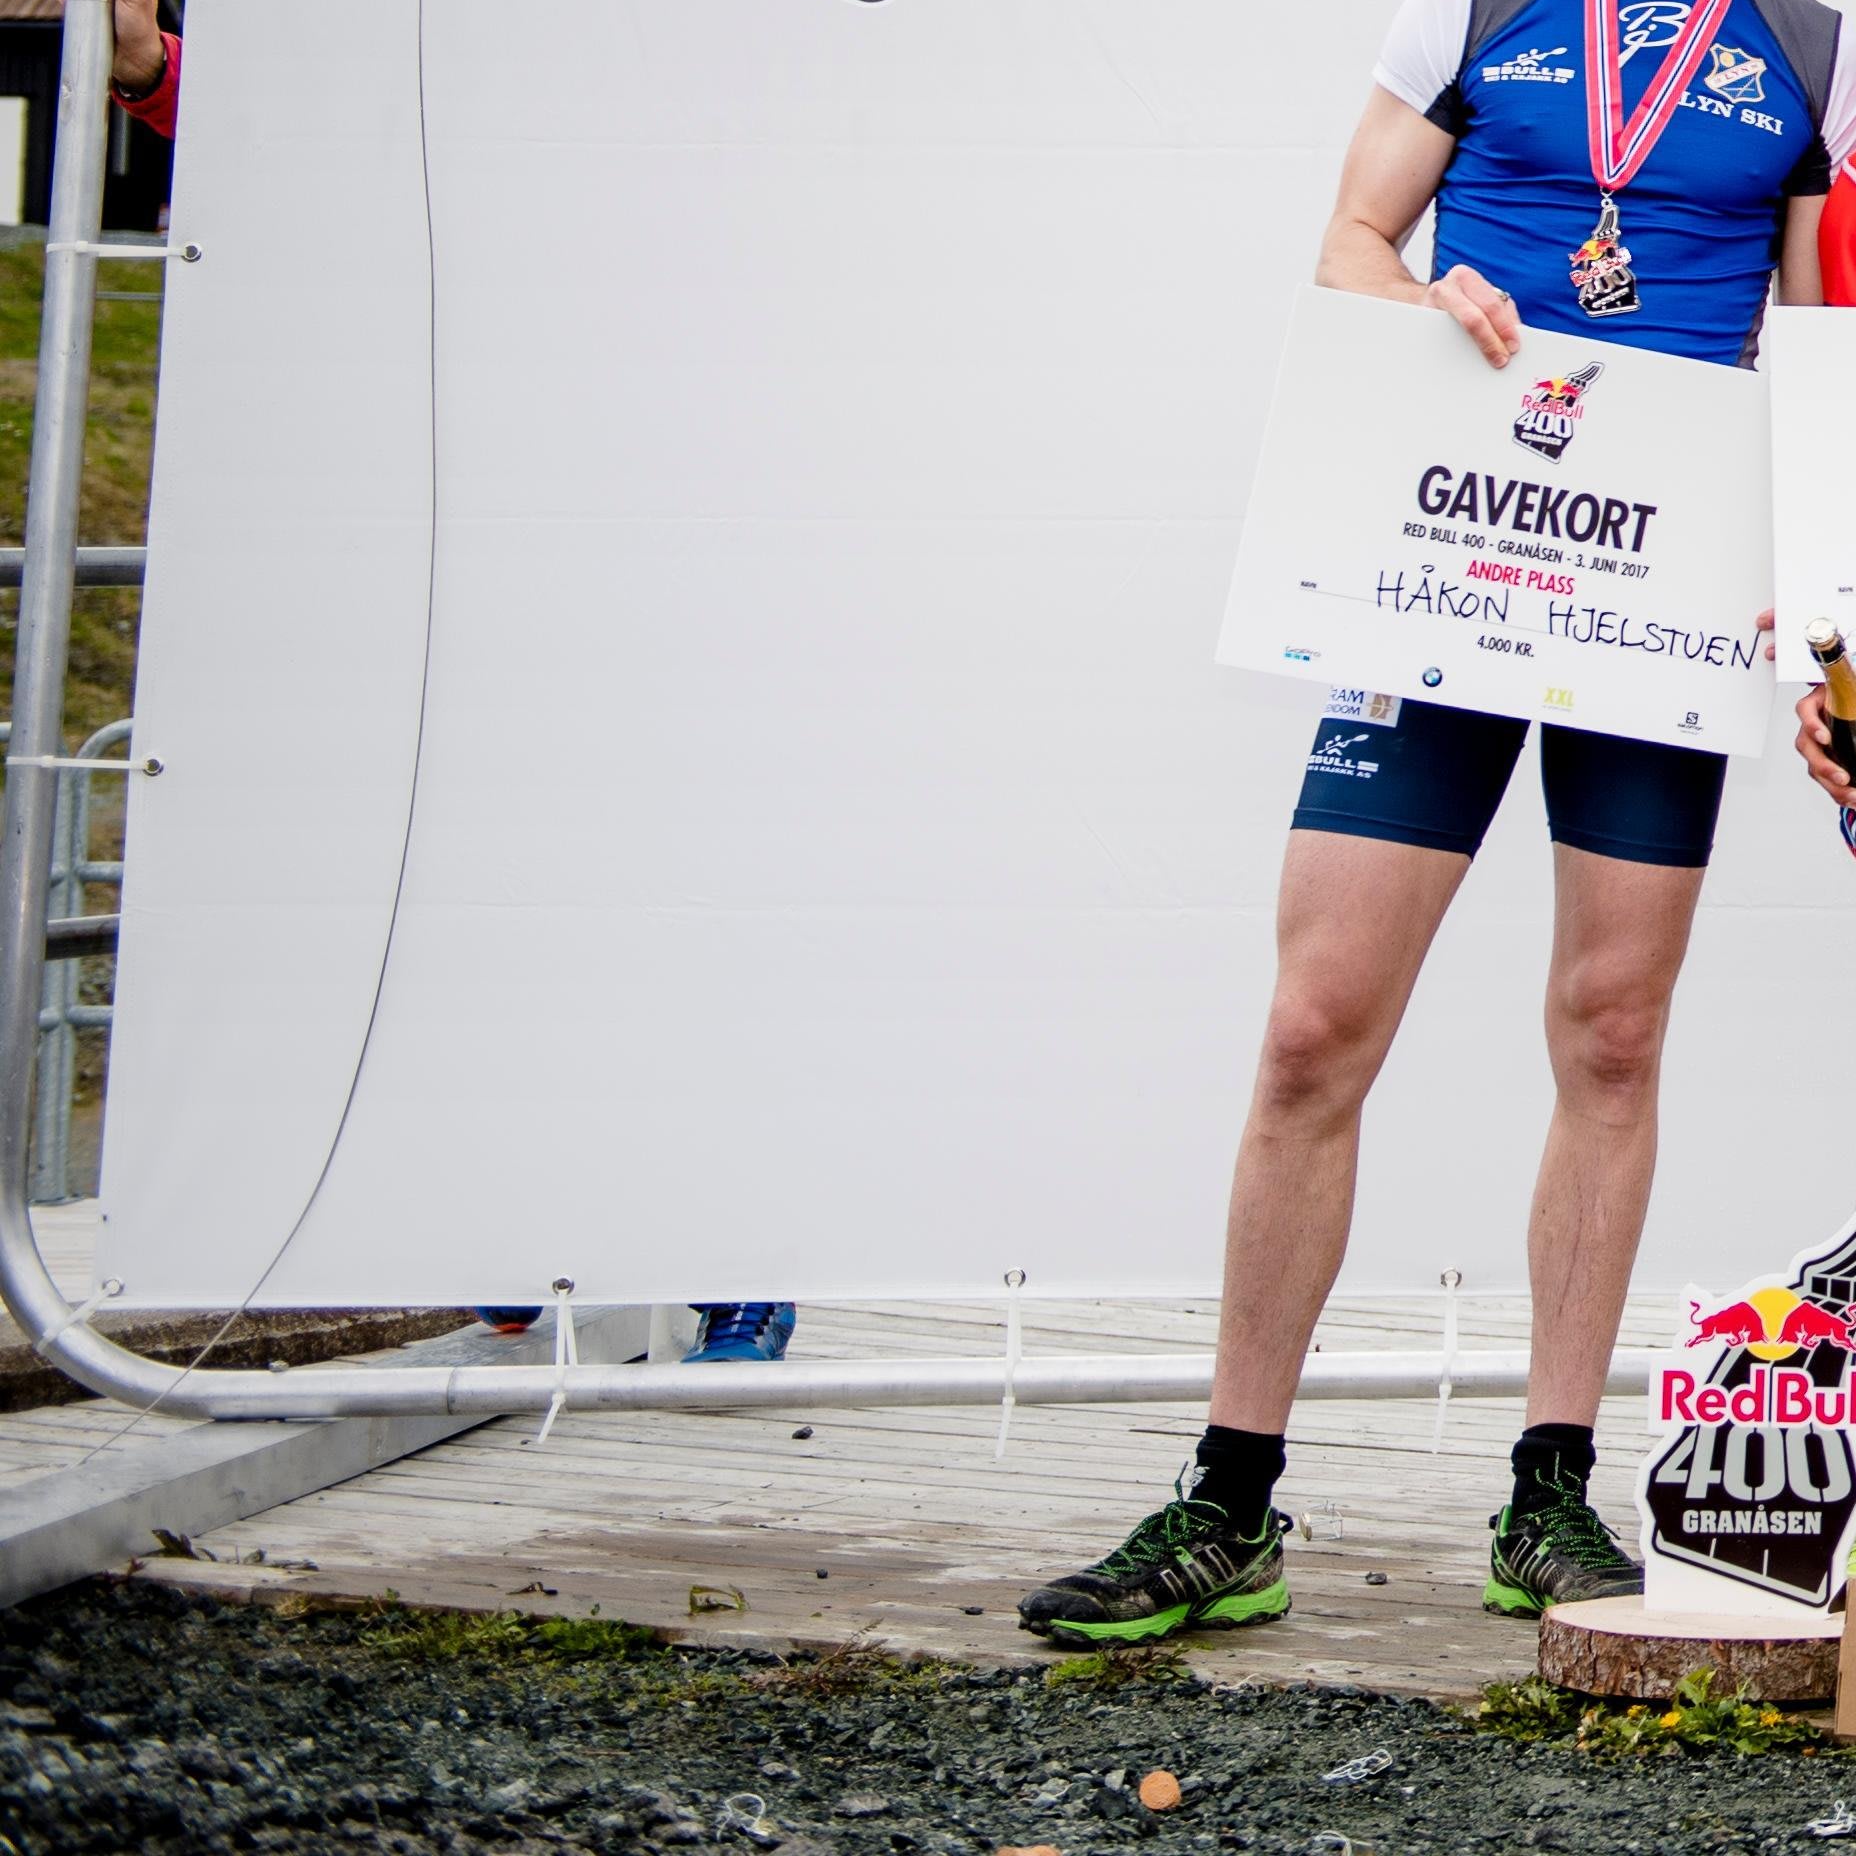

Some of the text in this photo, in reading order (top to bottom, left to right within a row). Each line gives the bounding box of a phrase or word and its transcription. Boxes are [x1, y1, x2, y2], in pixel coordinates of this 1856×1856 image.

[1678, 91, 1783, 136] LYN SKI
[1515, 409, 1573, 438] 400
[1417, 465, 1657, 553] GAVEKORT
[1403, 522, 1426, 538] RED
[1429, 526, 1457, 545] BULL
[1462, 533, 1485, 549] 400
[1498, 540, 1563, 564] GRANÅSEN
[1575, 554, 1585, 568] 3.
[1589, 556, 1617, 574] JUNI
[1622, 562, 1650, 579] 2017
[1466, 560, 1575, 595] ANDRE PLASS
[1376, 565, 1763, 670] HÅKON HJELSTUEN
[1477, 635, 1535, 657] 4.000 KR.
[1544, 687, 1575, 707] XXL
[1661, 1369, 1766, 1425] Red
[1655, 1427, 1852, 1503] 400
[1682, 1504, 1822, 1535] GRANÅSEN
